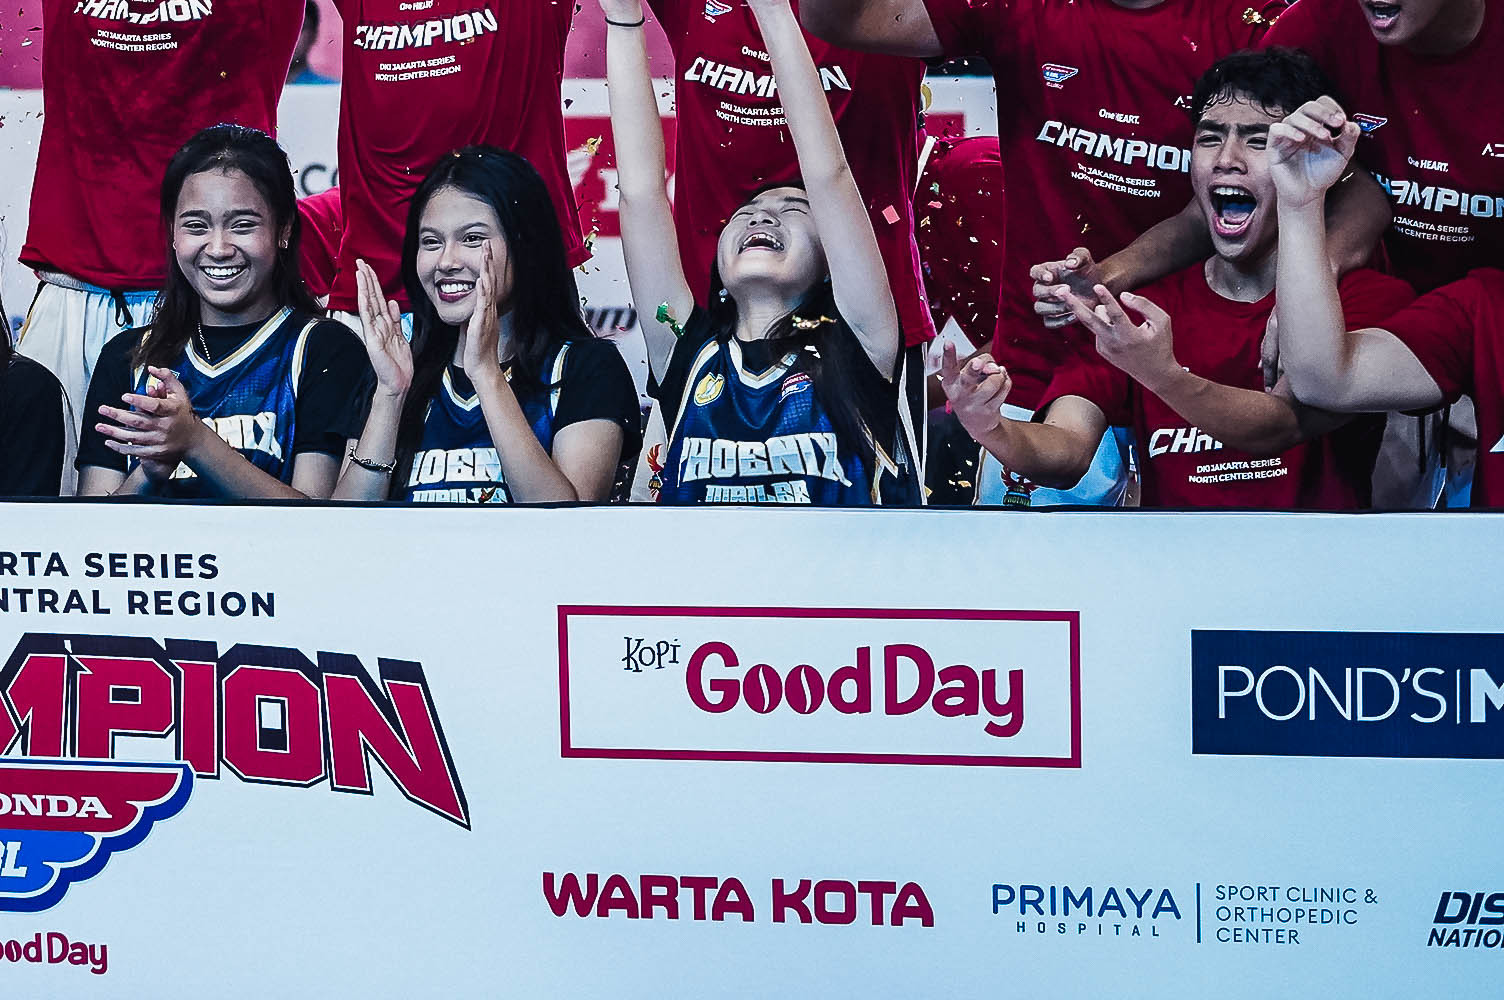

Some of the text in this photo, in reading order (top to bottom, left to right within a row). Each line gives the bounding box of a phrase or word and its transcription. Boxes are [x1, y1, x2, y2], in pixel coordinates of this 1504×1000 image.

[109, 31, 141, 42] JAKARTA
[143, 32, 172, 41] SERIES
[114, 42, 144, 51] CENTER
[145, 41, 177, 51] REGION
[391, 60, 427, 71] JAKARTA
[427, 55, 456, 66] SERIES
[398, 69, 430, 81] CENTER
[430, 64, 461, 77] REGION
[733, 104, 769, 116] JAKARTA
[741, 116, 773, 126] CENTER
[1087, 166, 1124, 183] JAKARTA
[1125, 177, 1156, 187] SERIES
[1093, 179, 1126, 193] CENTER
[1127, 187, 1160, 198] REGION
[1397, 216, 1435, 231] JAKARTA
[1436, 224, 1469, 233] SERIES
[1404, 228, 1438, 241] CENTER
[677, 432, 852, 488] PHOENIX
[1210, 461, 1249, 472] JAKARTA
[1250, 457, 1281, 468] SERIES
[1218, 471, 1254, 482] CENTER
[1254, 467, 1288, 480] REGION
[84, 552, 219, 580] SERIES
[127, 589, 275, 618] REGION
[542, 871, 935, 928] WARTA KOTA
[992, 884, 1181, 920] PRIMAYA
[1215, 885, 1379, 905] SPORT CLINIC &
[1215, 905, 1358, 925] ORTHOPEDIC
[1016, 922, 1160, 937] HOSPITAL
[1216, 927, 1301, 945] CENTER
